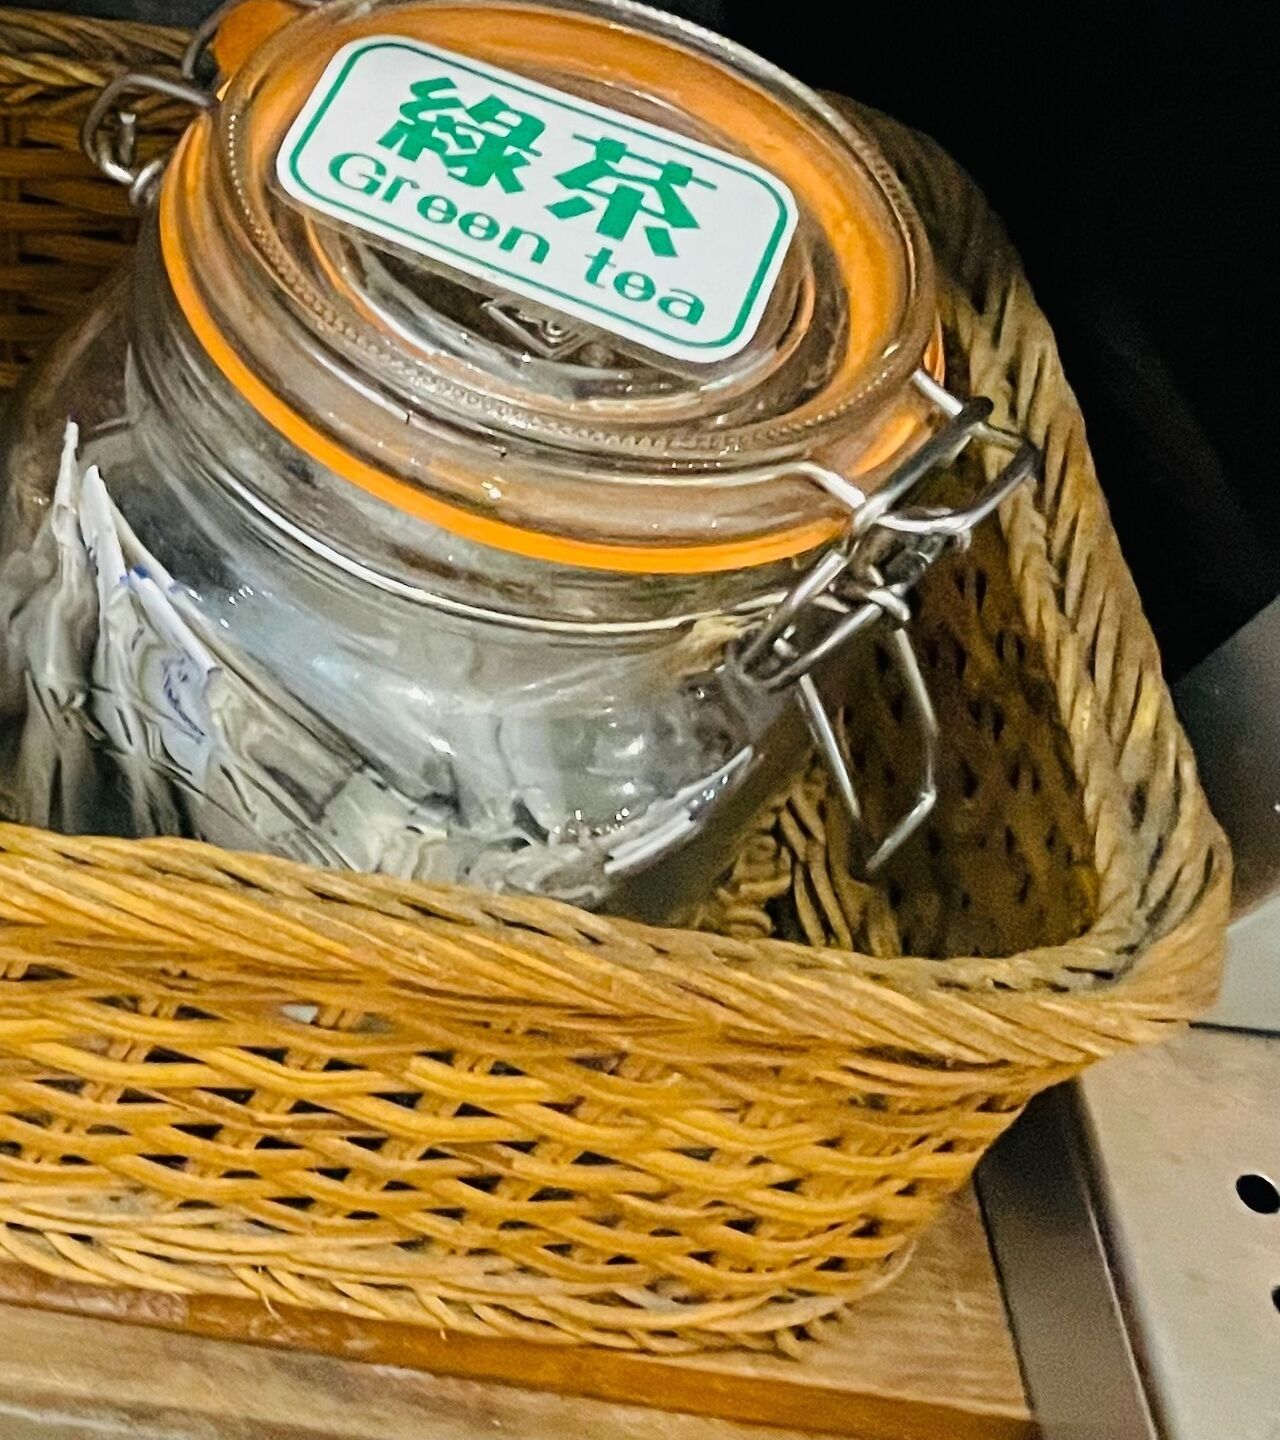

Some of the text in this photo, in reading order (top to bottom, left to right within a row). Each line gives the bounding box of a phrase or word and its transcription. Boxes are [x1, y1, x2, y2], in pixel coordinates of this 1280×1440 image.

[327, 150, 707, 327] Green tea
[378, 76, 719, 258] 綠茶
